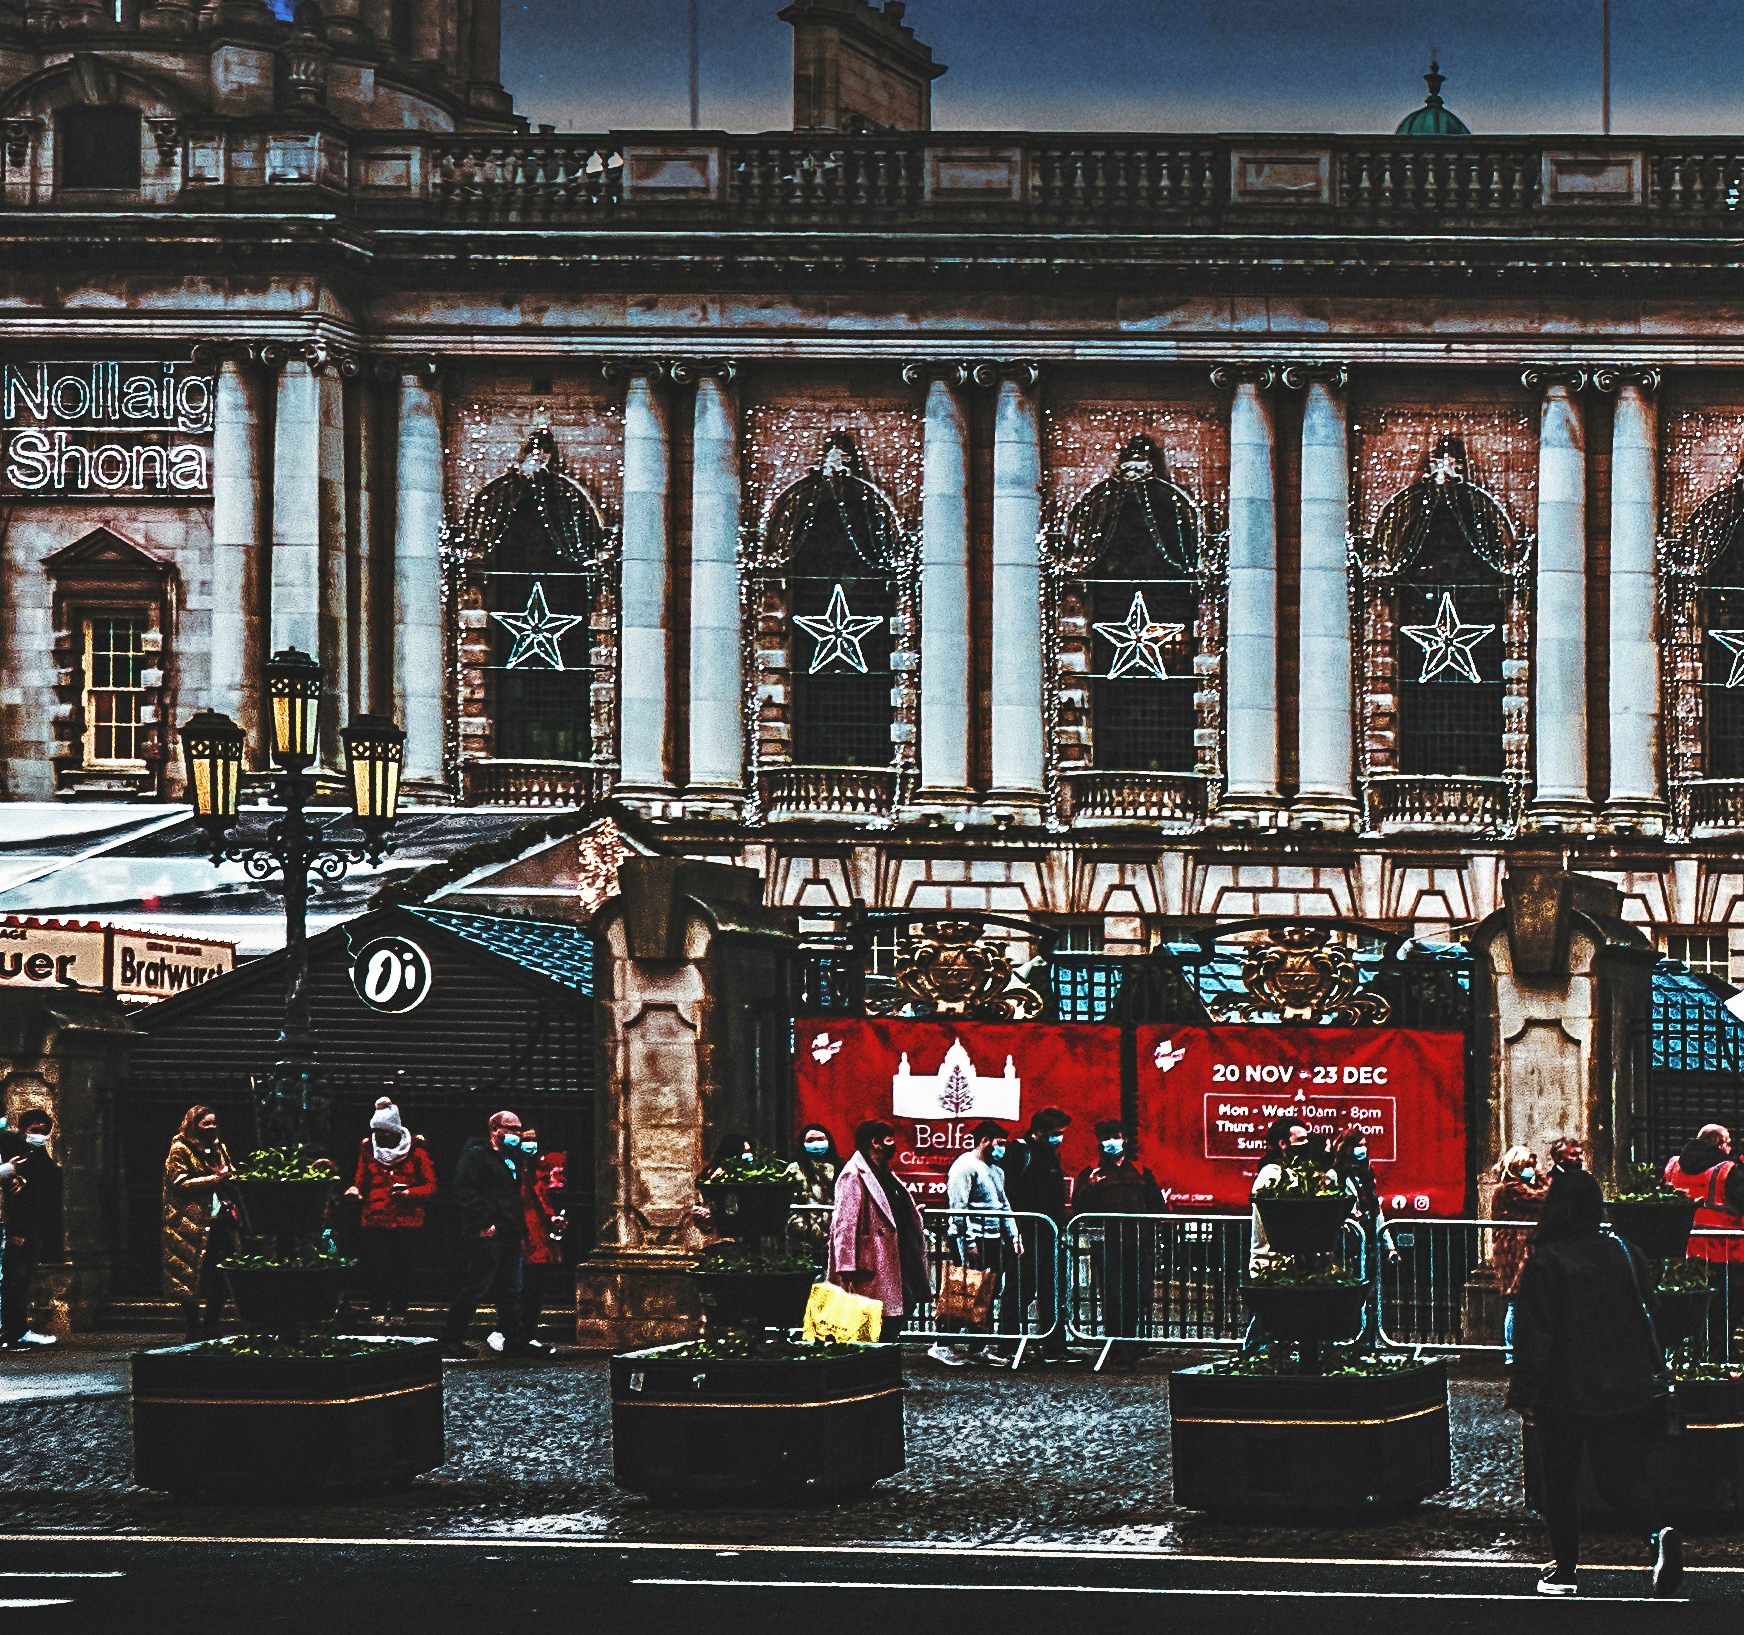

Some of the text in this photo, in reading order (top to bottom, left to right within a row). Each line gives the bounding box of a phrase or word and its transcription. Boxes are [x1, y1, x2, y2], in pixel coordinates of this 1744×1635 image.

[4, 362, 214, 432] Nollaig
[7, 431, 208, 490] Shona
[0, 928, 28, 941] AGE
[0, 951, 77, 983] uer
[1212, 1064, 1240, 1082] 20
[1245, 1065, 1294, 1083] NOV
[1312, 1066, 1338, 1084] 23
[1343, 1066, 1388, 1085] DEC
[1218, 1104, 1249, 1117] Mon
[1261, 1105, 1299, 1117] Wed:
[1301, 1105, 1337, 1118] 10am
[1350, 1106, 1382, 1120] 8pm
[915, 1122, 975, 1149] Belfa
[1215, 1120, 1255, 1133] Thurs
[1305, 1121, 1334, 1134] 0am
[1237, 1137, 1267, 1150] Sun:
[928, 1182, 948, 1194] 20
